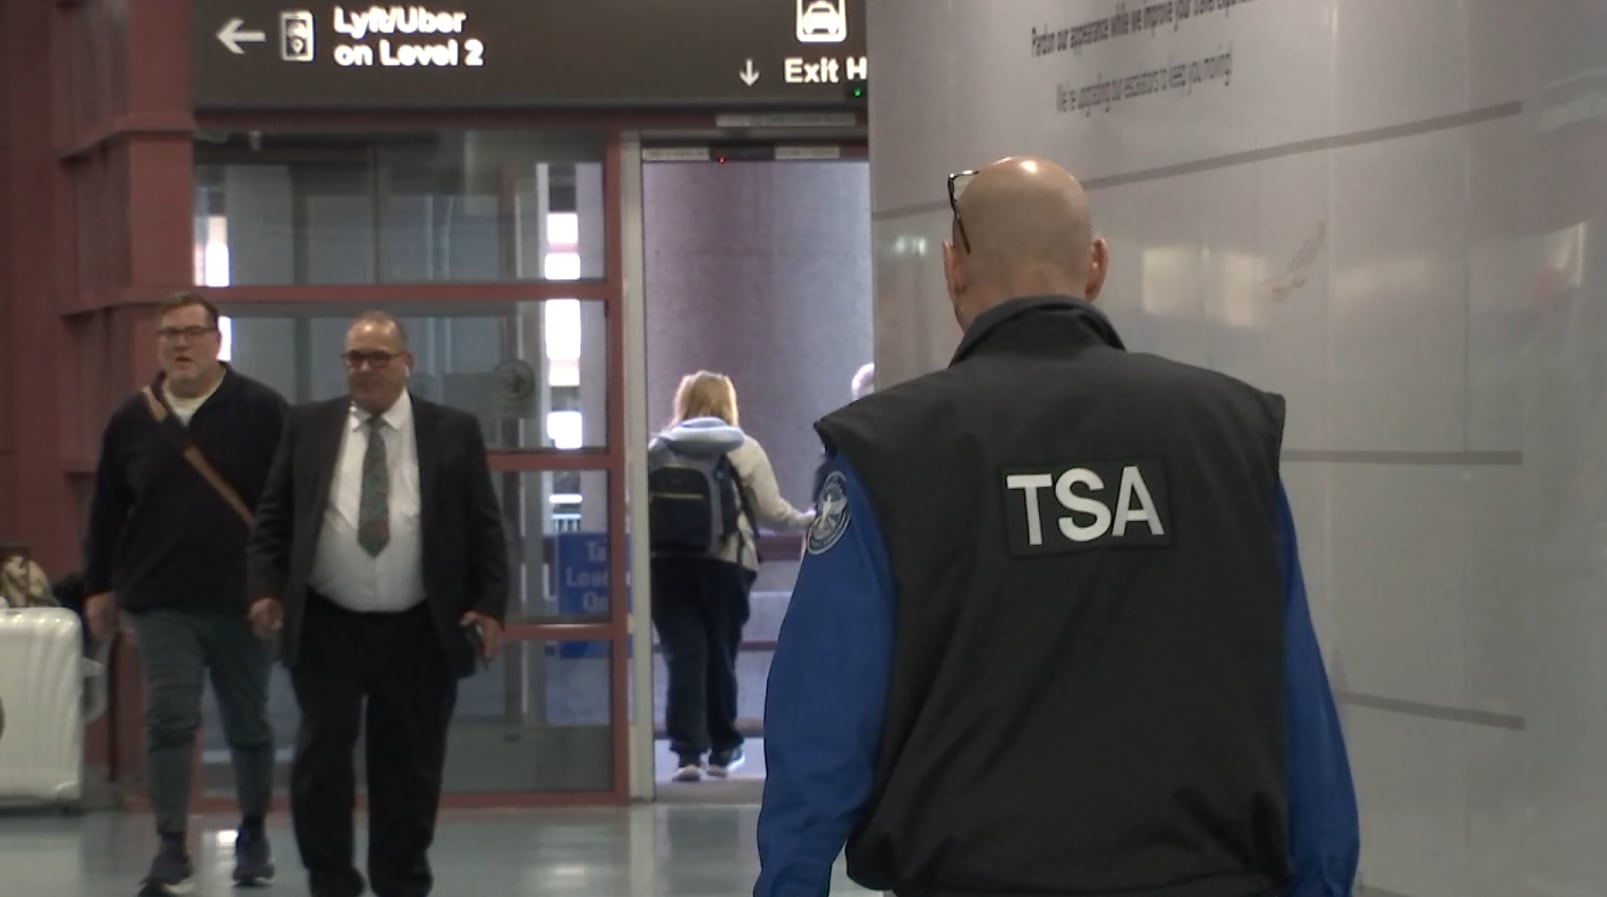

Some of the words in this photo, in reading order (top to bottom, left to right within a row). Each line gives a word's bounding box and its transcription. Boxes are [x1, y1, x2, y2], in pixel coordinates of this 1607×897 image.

[334, 6, 467, 40] Lyft/Uber
[1032, 26, 1055, 57] Pardon
[1056, 28, 1069, 52] our
[1070, 17, 1108, 56] appearance
[1110, 2, 1129, 38] while
[1130, 9, 1142, 34] we
[1143, 0, 1173, 37] improve
[334, 44, 374, 67] on
[379, 38, 459, 67] Level
[464, 38, 485, 67] 2
[784, 56, 840, 83] Exit
[1056, 82, 1075, 113] We're
[1077, 73, 1111, 117] upgrading
[1111, 78, 1121, 102] our
[1123, 62, 1158, 99] escalators
[1168, 53, 1186, 100] keep
[1187, 61, 1201, 97] you
[1006, 465, 1165, 546] TSA
